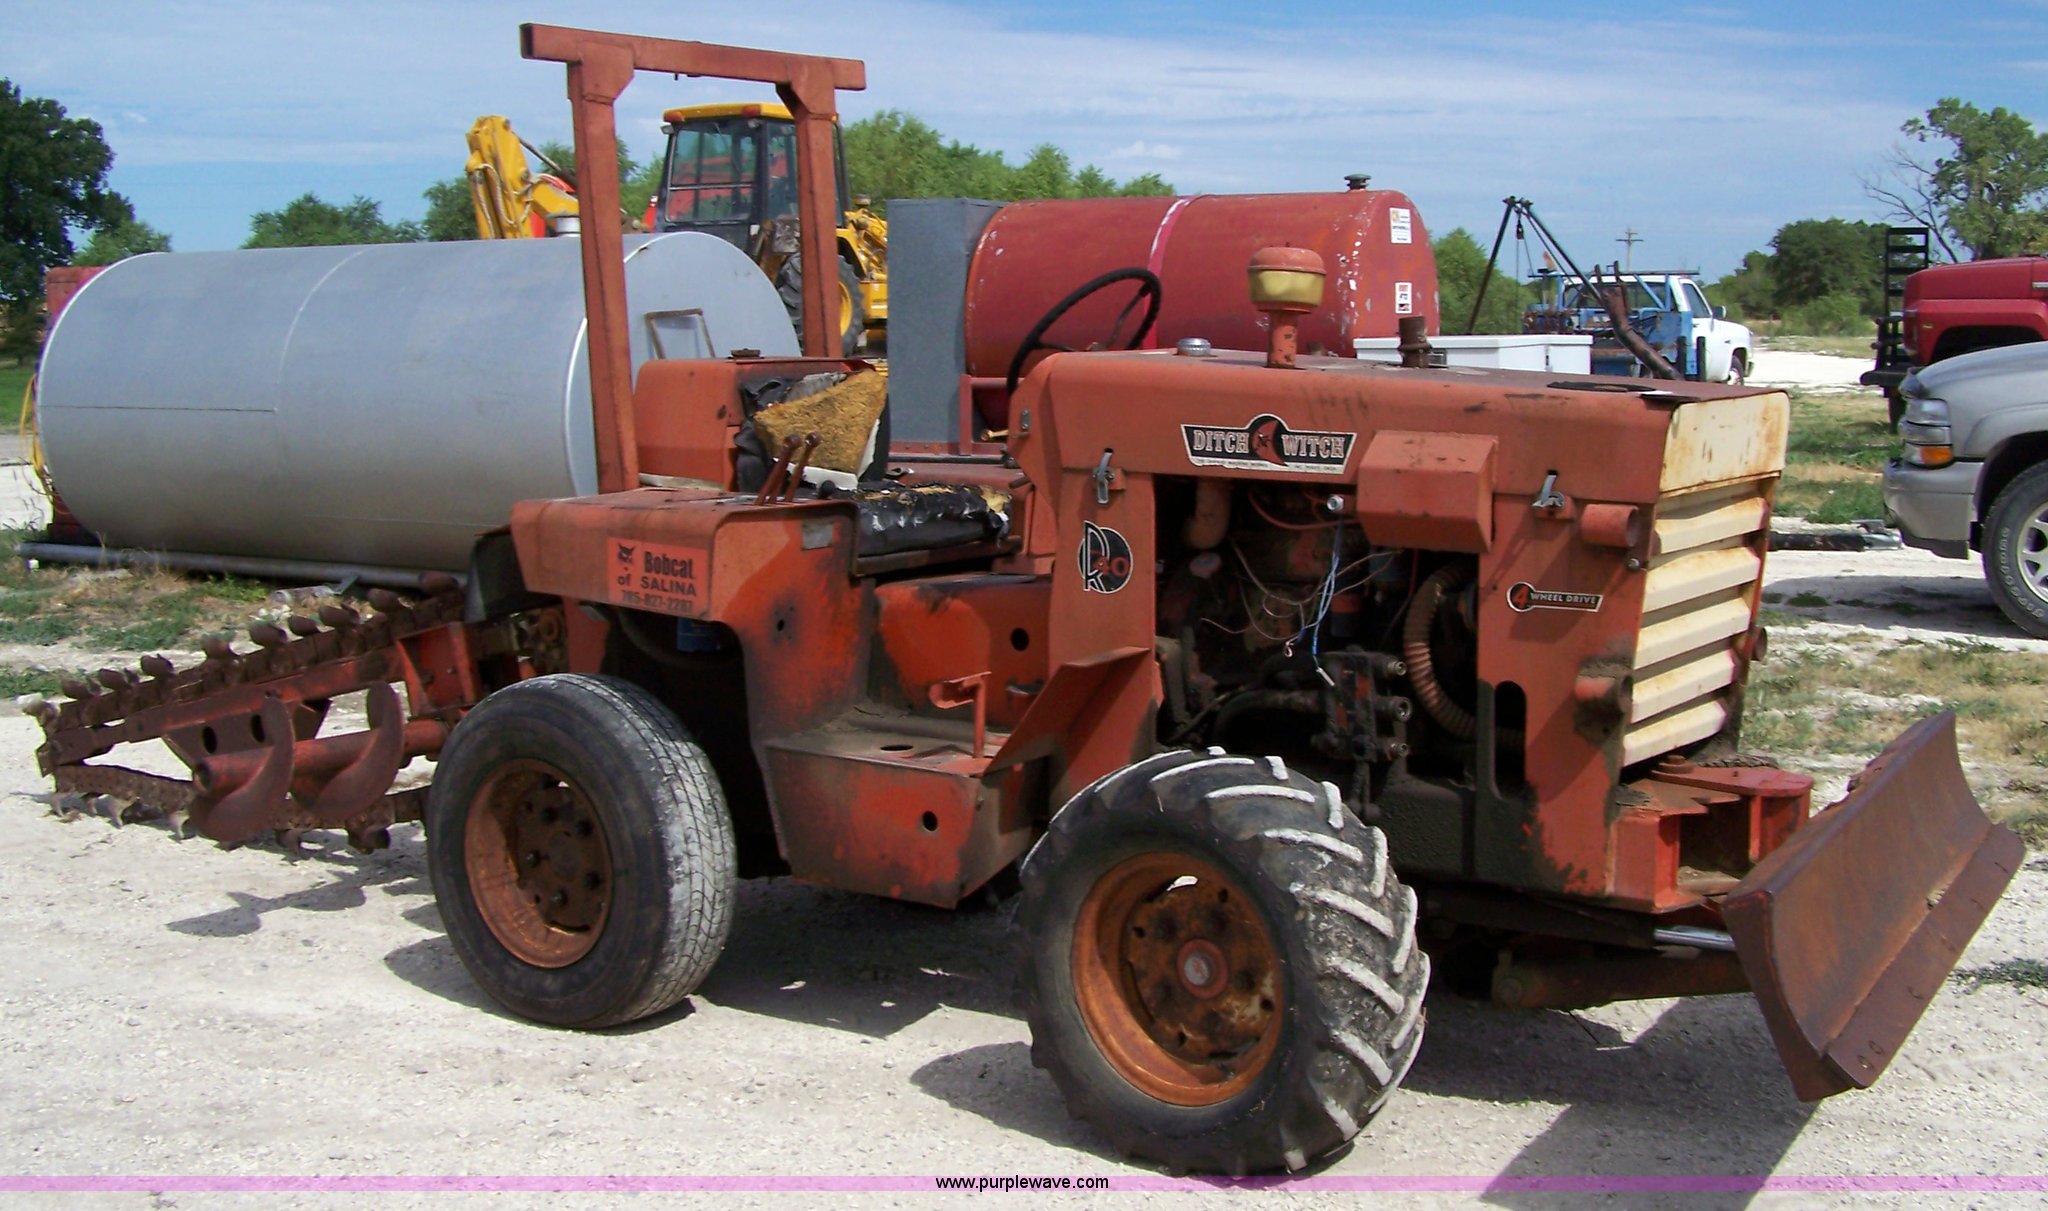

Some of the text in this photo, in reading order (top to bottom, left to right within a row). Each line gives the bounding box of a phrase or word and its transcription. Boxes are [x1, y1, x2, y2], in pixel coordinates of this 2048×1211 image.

[1193, 430, 1345, 458] DITCH WITCH
[644, 552, 693, 578] Bobcat
[618, 574, 696, 596] of SALINA
[1530, 593, 1563, 602] WHEEL
[1565, 595, 1597, 604] DRIVE
